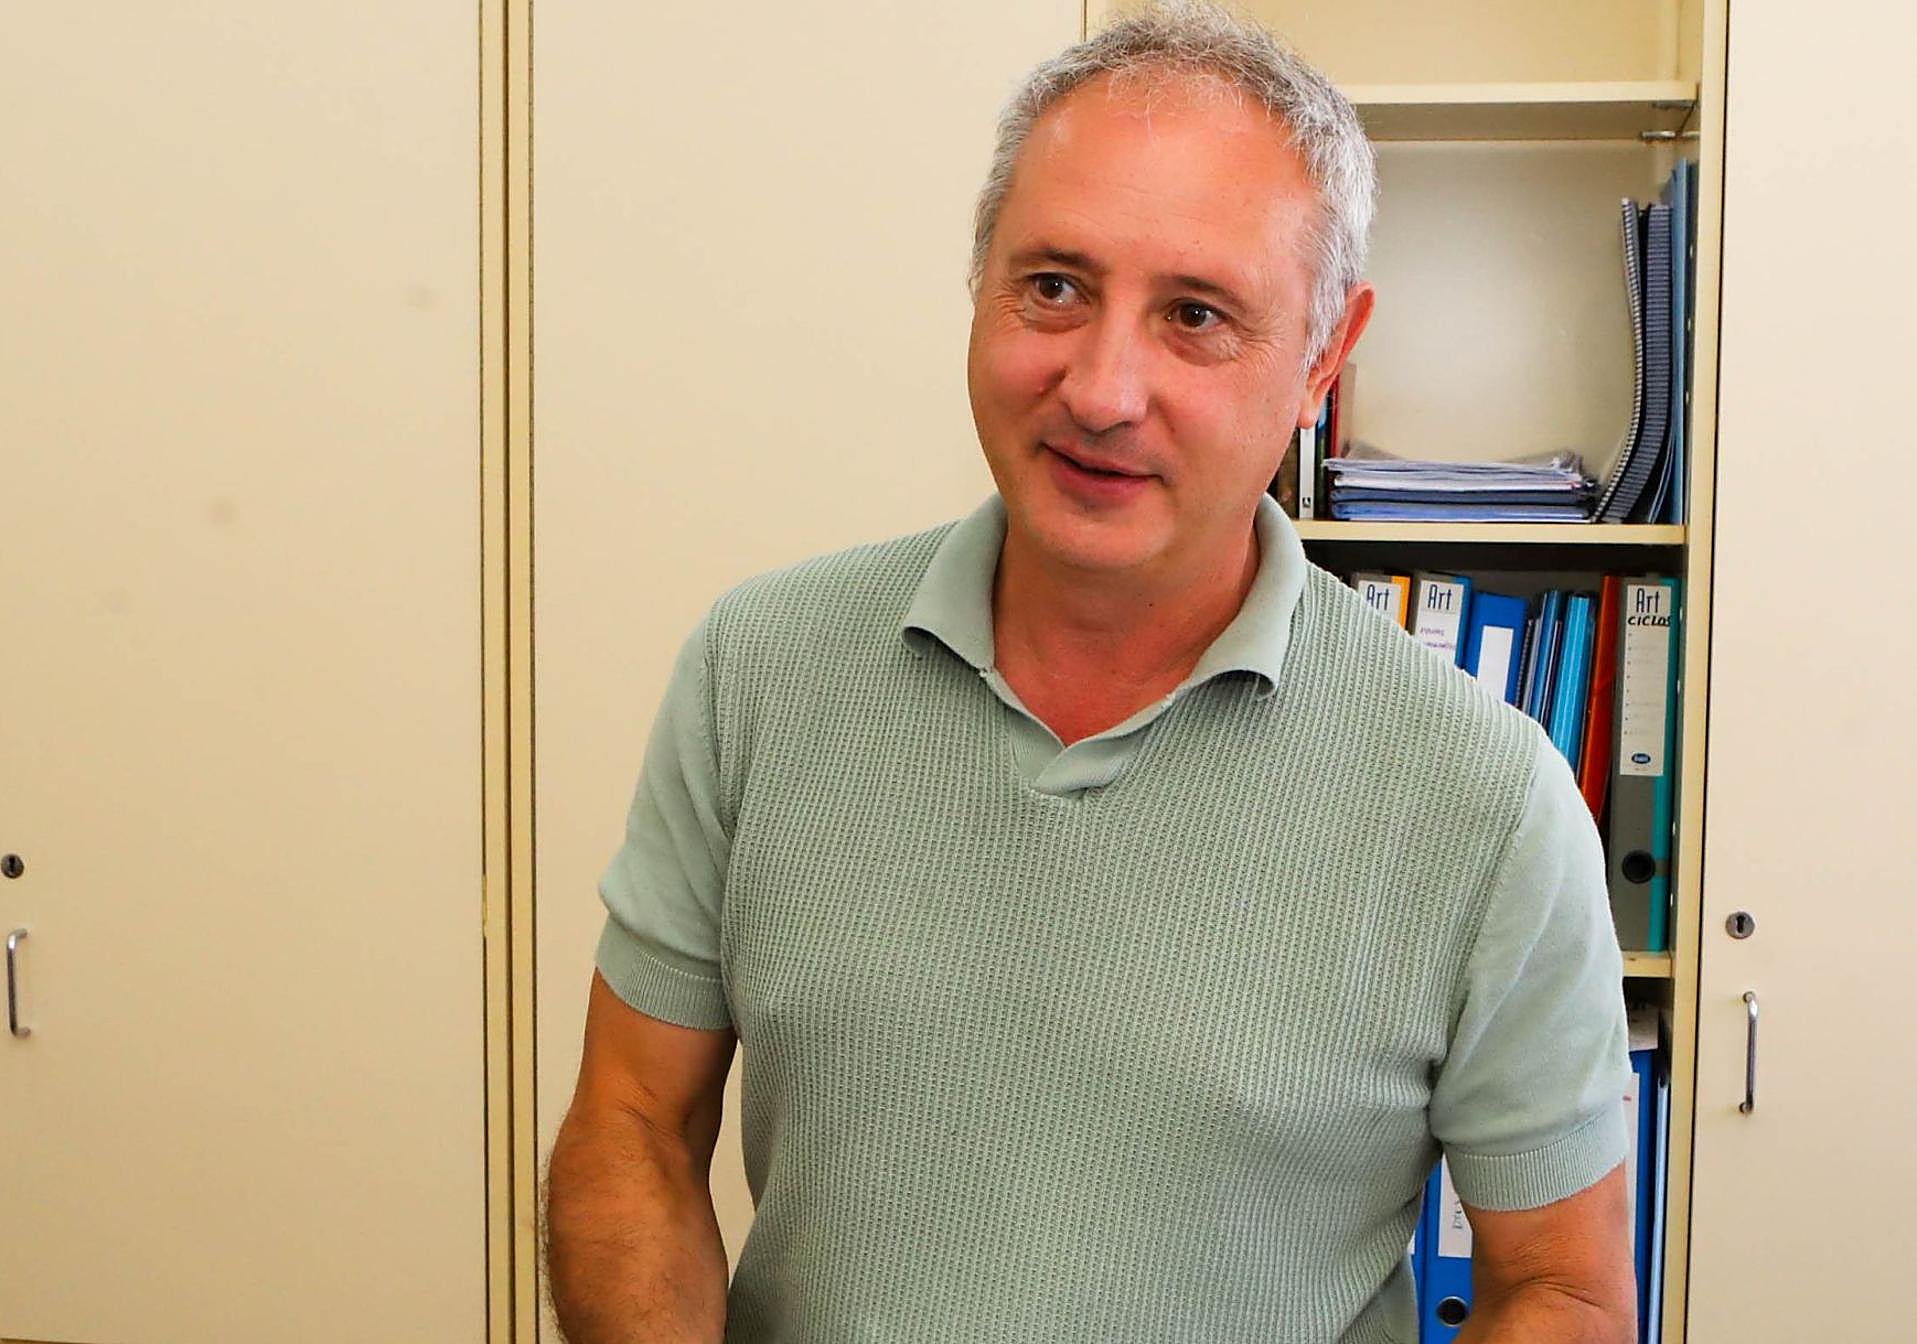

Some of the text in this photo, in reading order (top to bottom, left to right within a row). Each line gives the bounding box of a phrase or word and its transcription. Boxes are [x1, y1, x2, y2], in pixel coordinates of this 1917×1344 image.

[1367, 584, 1389, 610] Art
[1428, 584, 1452, 610] Art
[1636, 588, 1660, 613] Art
[1628, 615, 1671, 627] CICLOS
